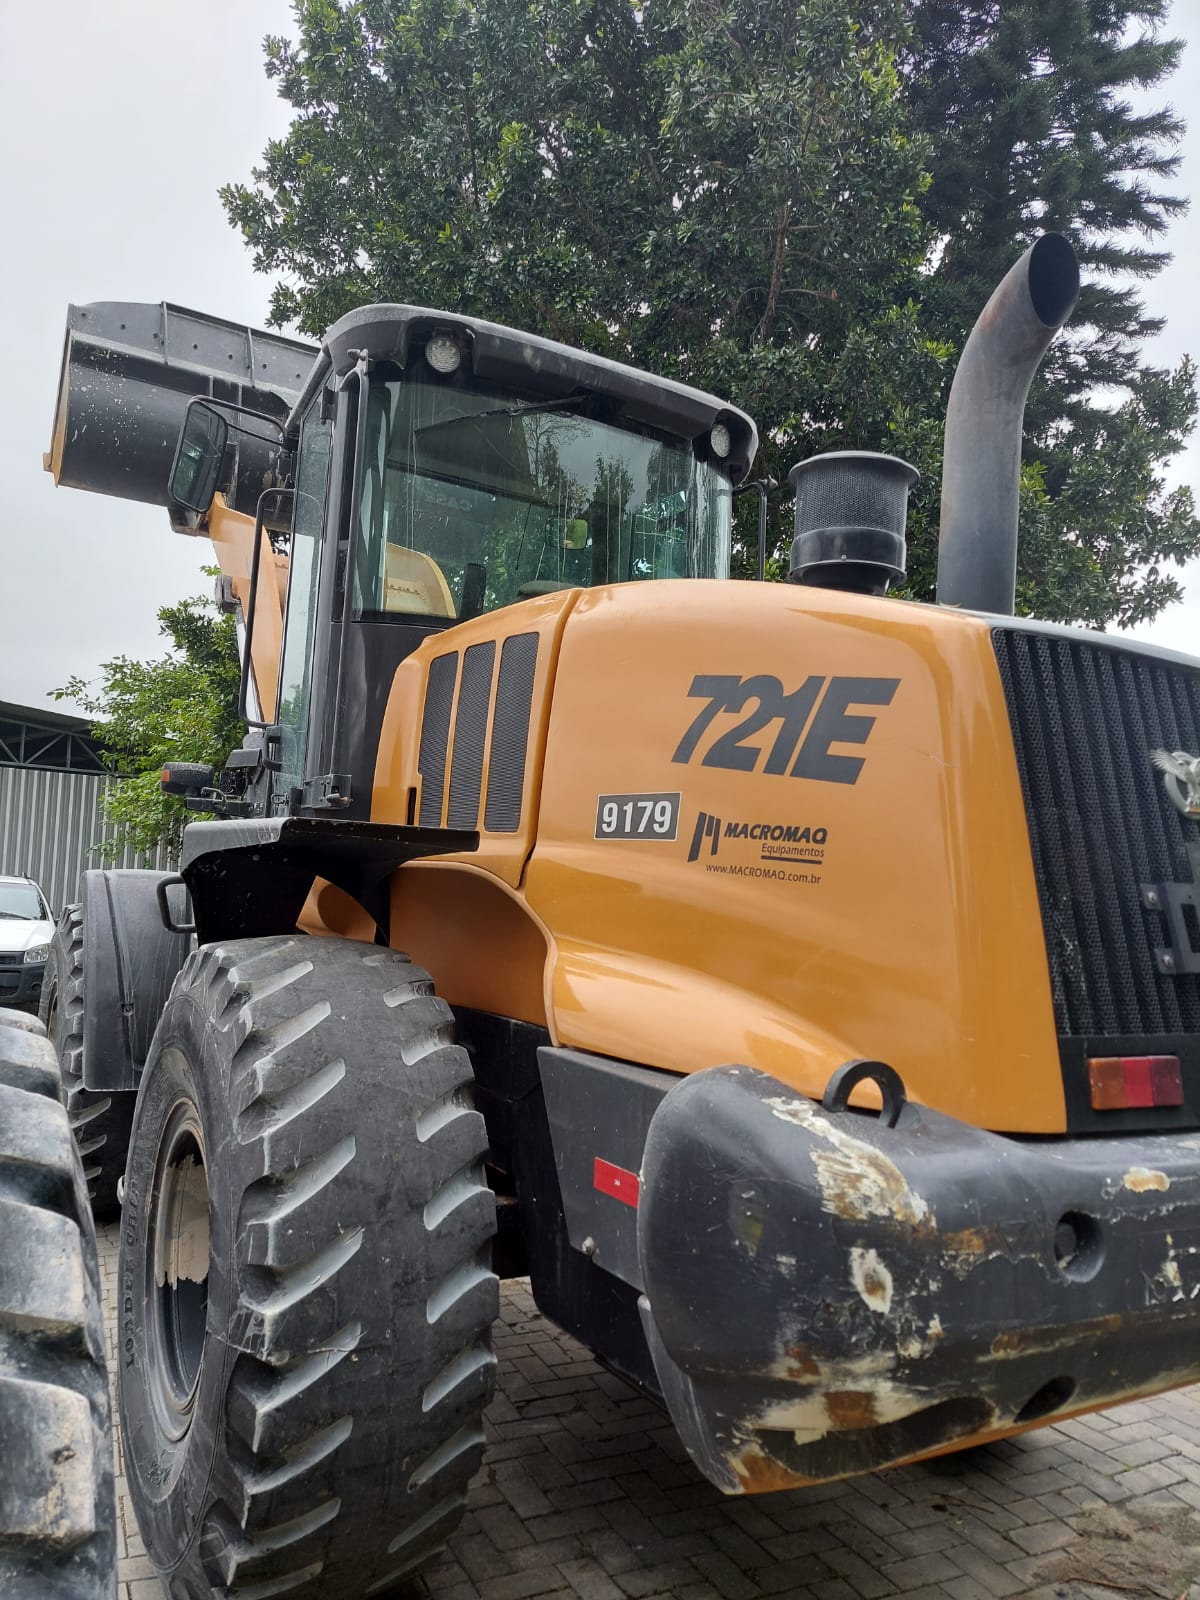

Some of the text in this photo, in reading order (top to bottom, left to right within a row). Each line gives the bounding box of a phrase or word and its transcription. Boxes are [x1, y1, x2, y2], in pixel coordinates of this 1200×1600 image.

[671, 674, 902, 785] 721E
[601, 800, 672, 834] 9179
[724, 822, 828, 845] MACROMAQ
[761, 843, 825, 858] Equipamentos
[705, 863, 822, 884] www.MACROMAQ.com.br
